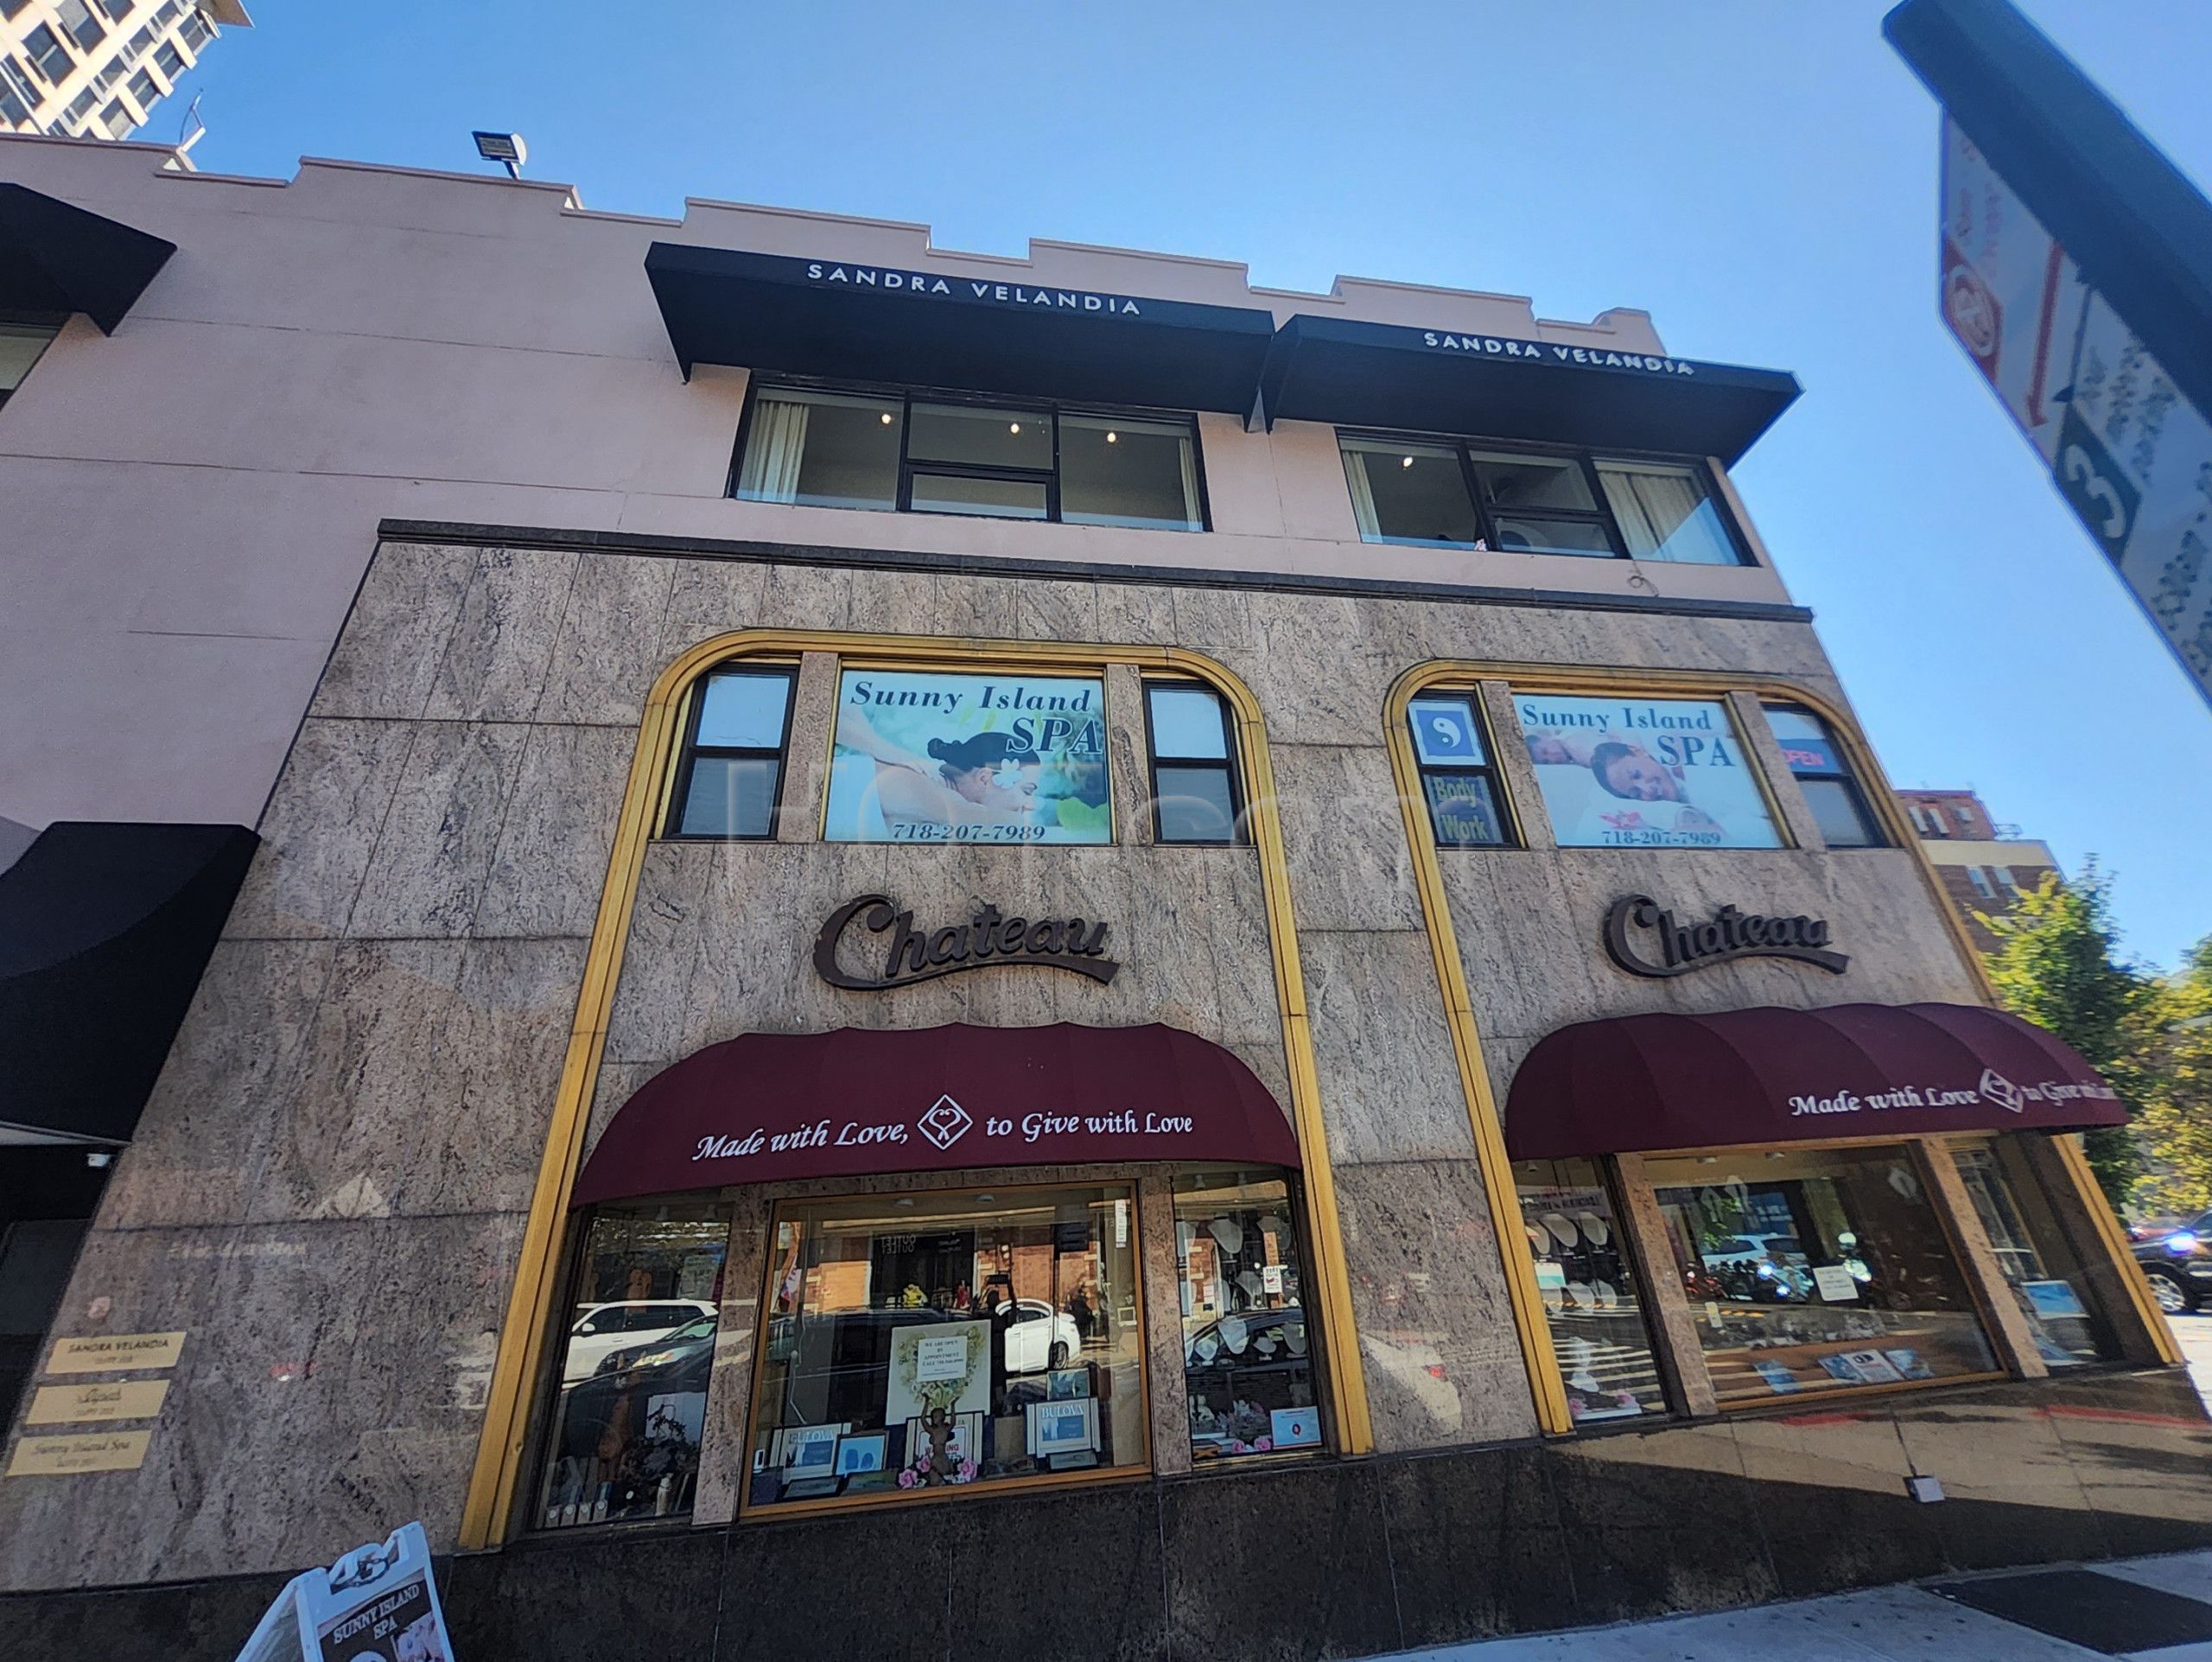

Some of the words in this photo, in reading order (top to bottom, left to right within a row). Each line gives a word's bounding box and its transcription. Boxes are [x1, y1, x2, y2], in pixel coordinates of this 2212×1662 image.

[807, 264, 950, 295] SANDRA
[970, 283, 1141, 315] VELANDIA
[1424, 332, 1541, 359] SANDRA
[1553, 346, 1694, 376] VELANDIA
[850, 681, 963, 714] Sunny
[978, 686, 1092, 712] Island
[1522, 704, 1611, 732] Sunny
[1622, 707, 1712, 730] Island
[1006, 717, 1103, 755] SPA
[1656, 735, 1736, 767] SPA
[1433, 776, 1477, 808] Body
[893, 824, 1046, 841] 718-207-7989
[1440, 814, 1489, 840] Work
[1601, 831, 1722, 845] 718-207-7989
[813, 893, 1121, 991] Chateau
[1602, 894, 1850, 978] Chateau
[1789, 1090, 1861, 1116] Made
[1864, 1086, 1923, 1110] with
[692, 1128, 766, 1161] Made
[770, 1119, 831, 1152] with
[834, 1122, 909, 1146] Love,
[986, 1116, 1014, 1137] to
[1021, 1111, 1080, 1143] Give
[1085, 1110, 1139, 1133] with
[1144, 1112, 1193, 1133] Love
[1042, 1404, 1084, 1418] BULOVA
[334, 1609, 378, 1645] SUNNY
[378, 1583, 420, 1617] ISLAND
[373, 1616, 398, 1640] SPA
